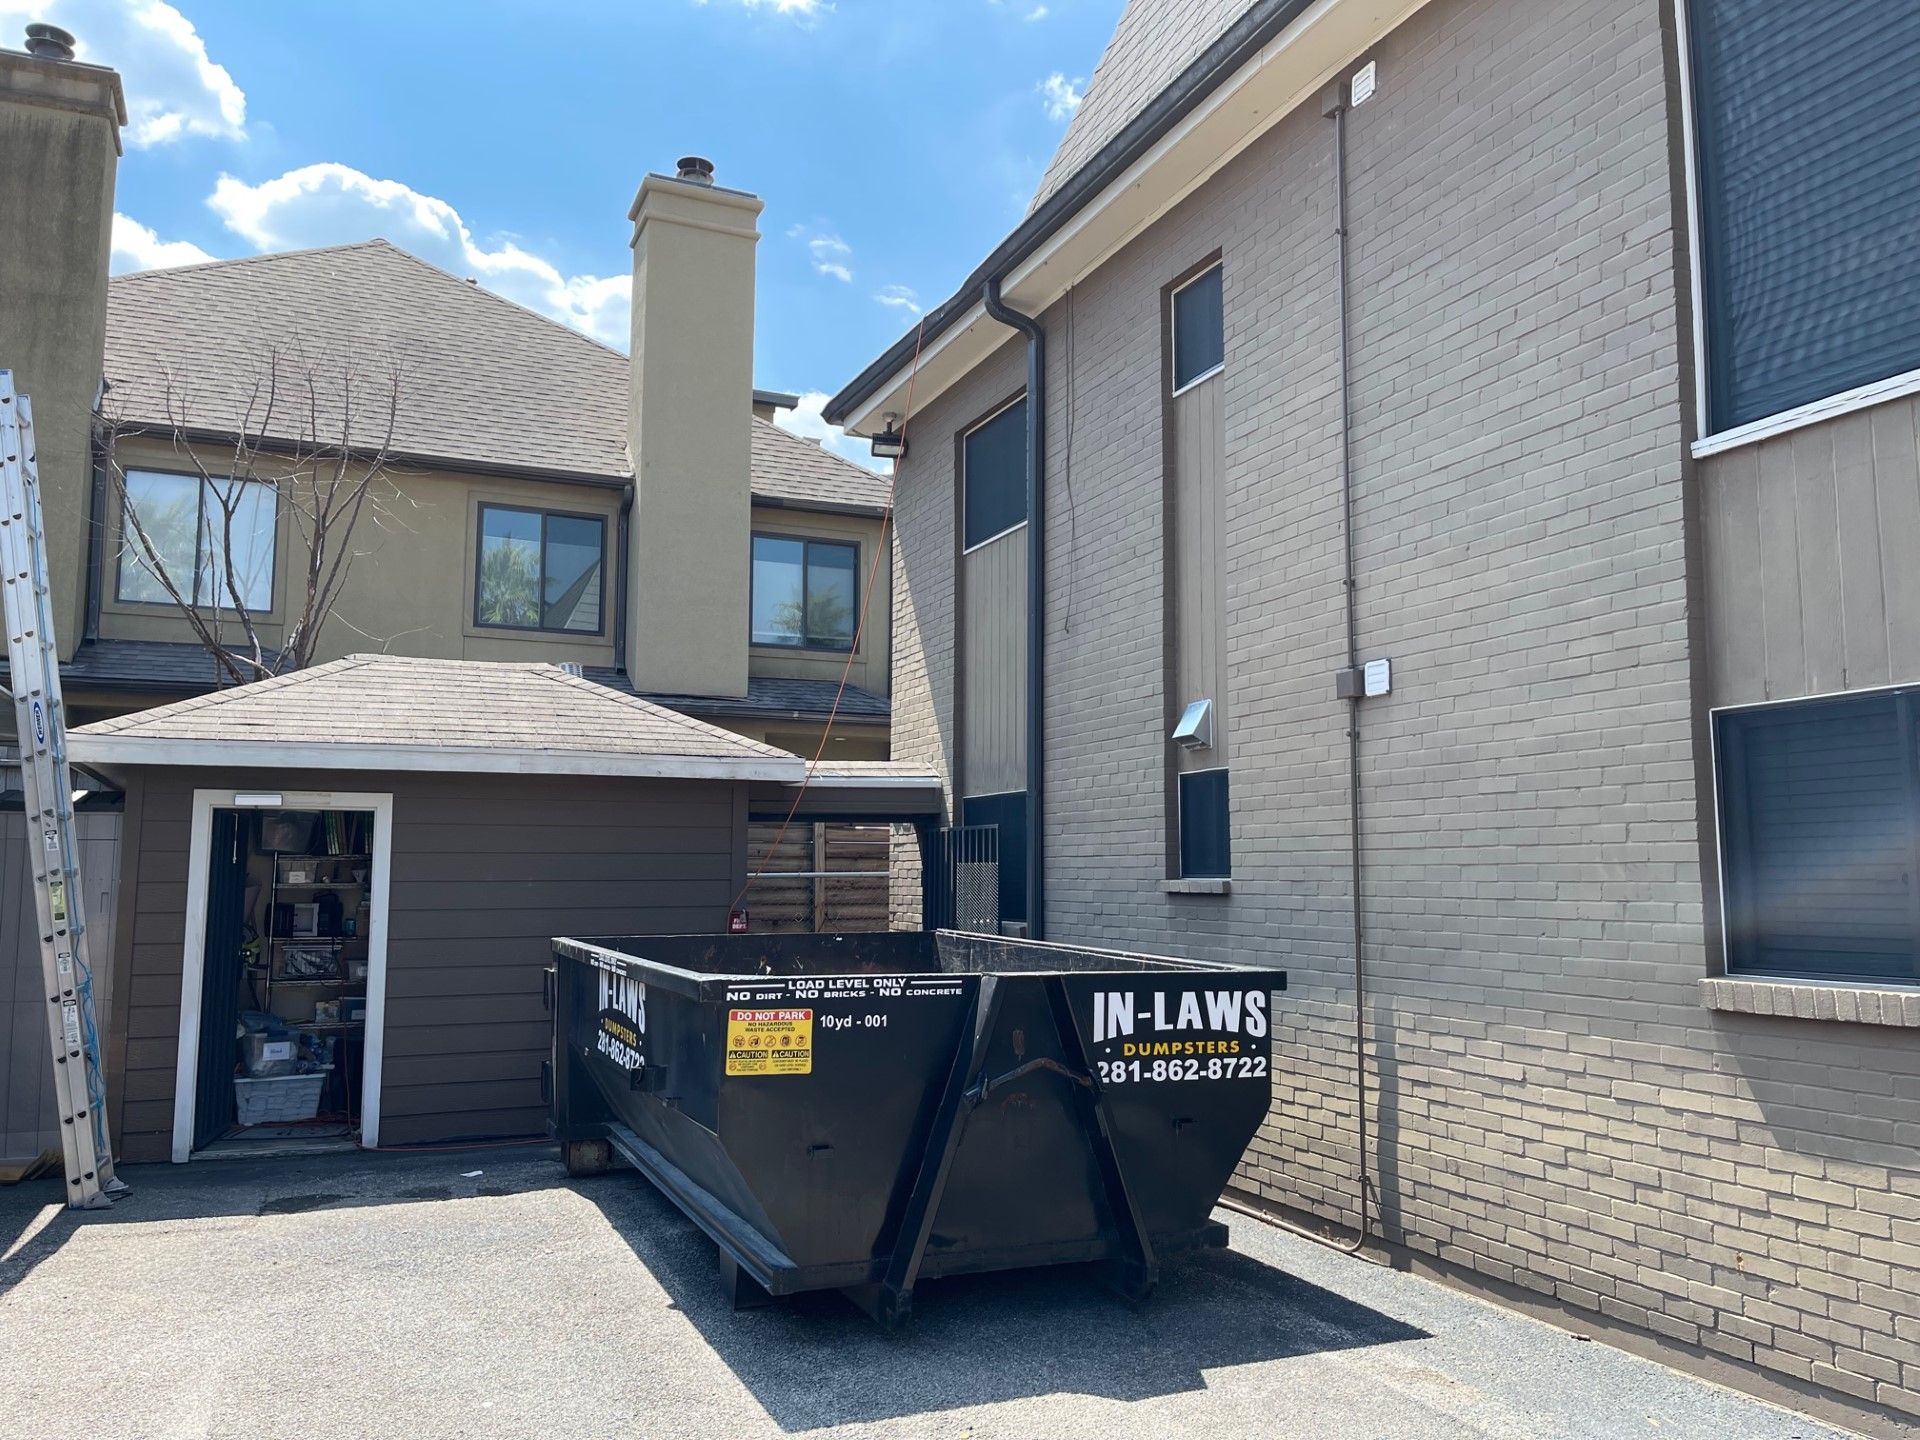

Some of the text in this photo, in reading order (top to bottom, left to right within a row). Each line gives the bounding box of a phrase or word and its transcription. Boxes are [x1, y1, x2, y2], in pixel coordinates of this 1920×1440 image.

[788, 978, 906, 990] LOAD LEVEL ONLY
[726, 991, 750, 1001] NO
[756, 992, 783, 1000] DIRT
[795, 990, 819, 999] NO
[823, 990, 866, 998] BRICKS
[879, 988, 901, 997] NO
[906, 988, 963, 996] CONCRETE
[737, 1011, 806, 1020] DO NOT PARK
[820, 1015, 852, 1031] 10yd
[864, 1014, 888, 1028] 001
[1093, 990, 1267, 1043] IN-LAWS
[605, 1017, 637, 1047] DUMPSTERS
[736, 1051, 768, 1059] CAUTION
[1123, 1040, 1240, 1057] DUMPSTERS
[1097, 1056, 1267, 1084] 281-862-8722
